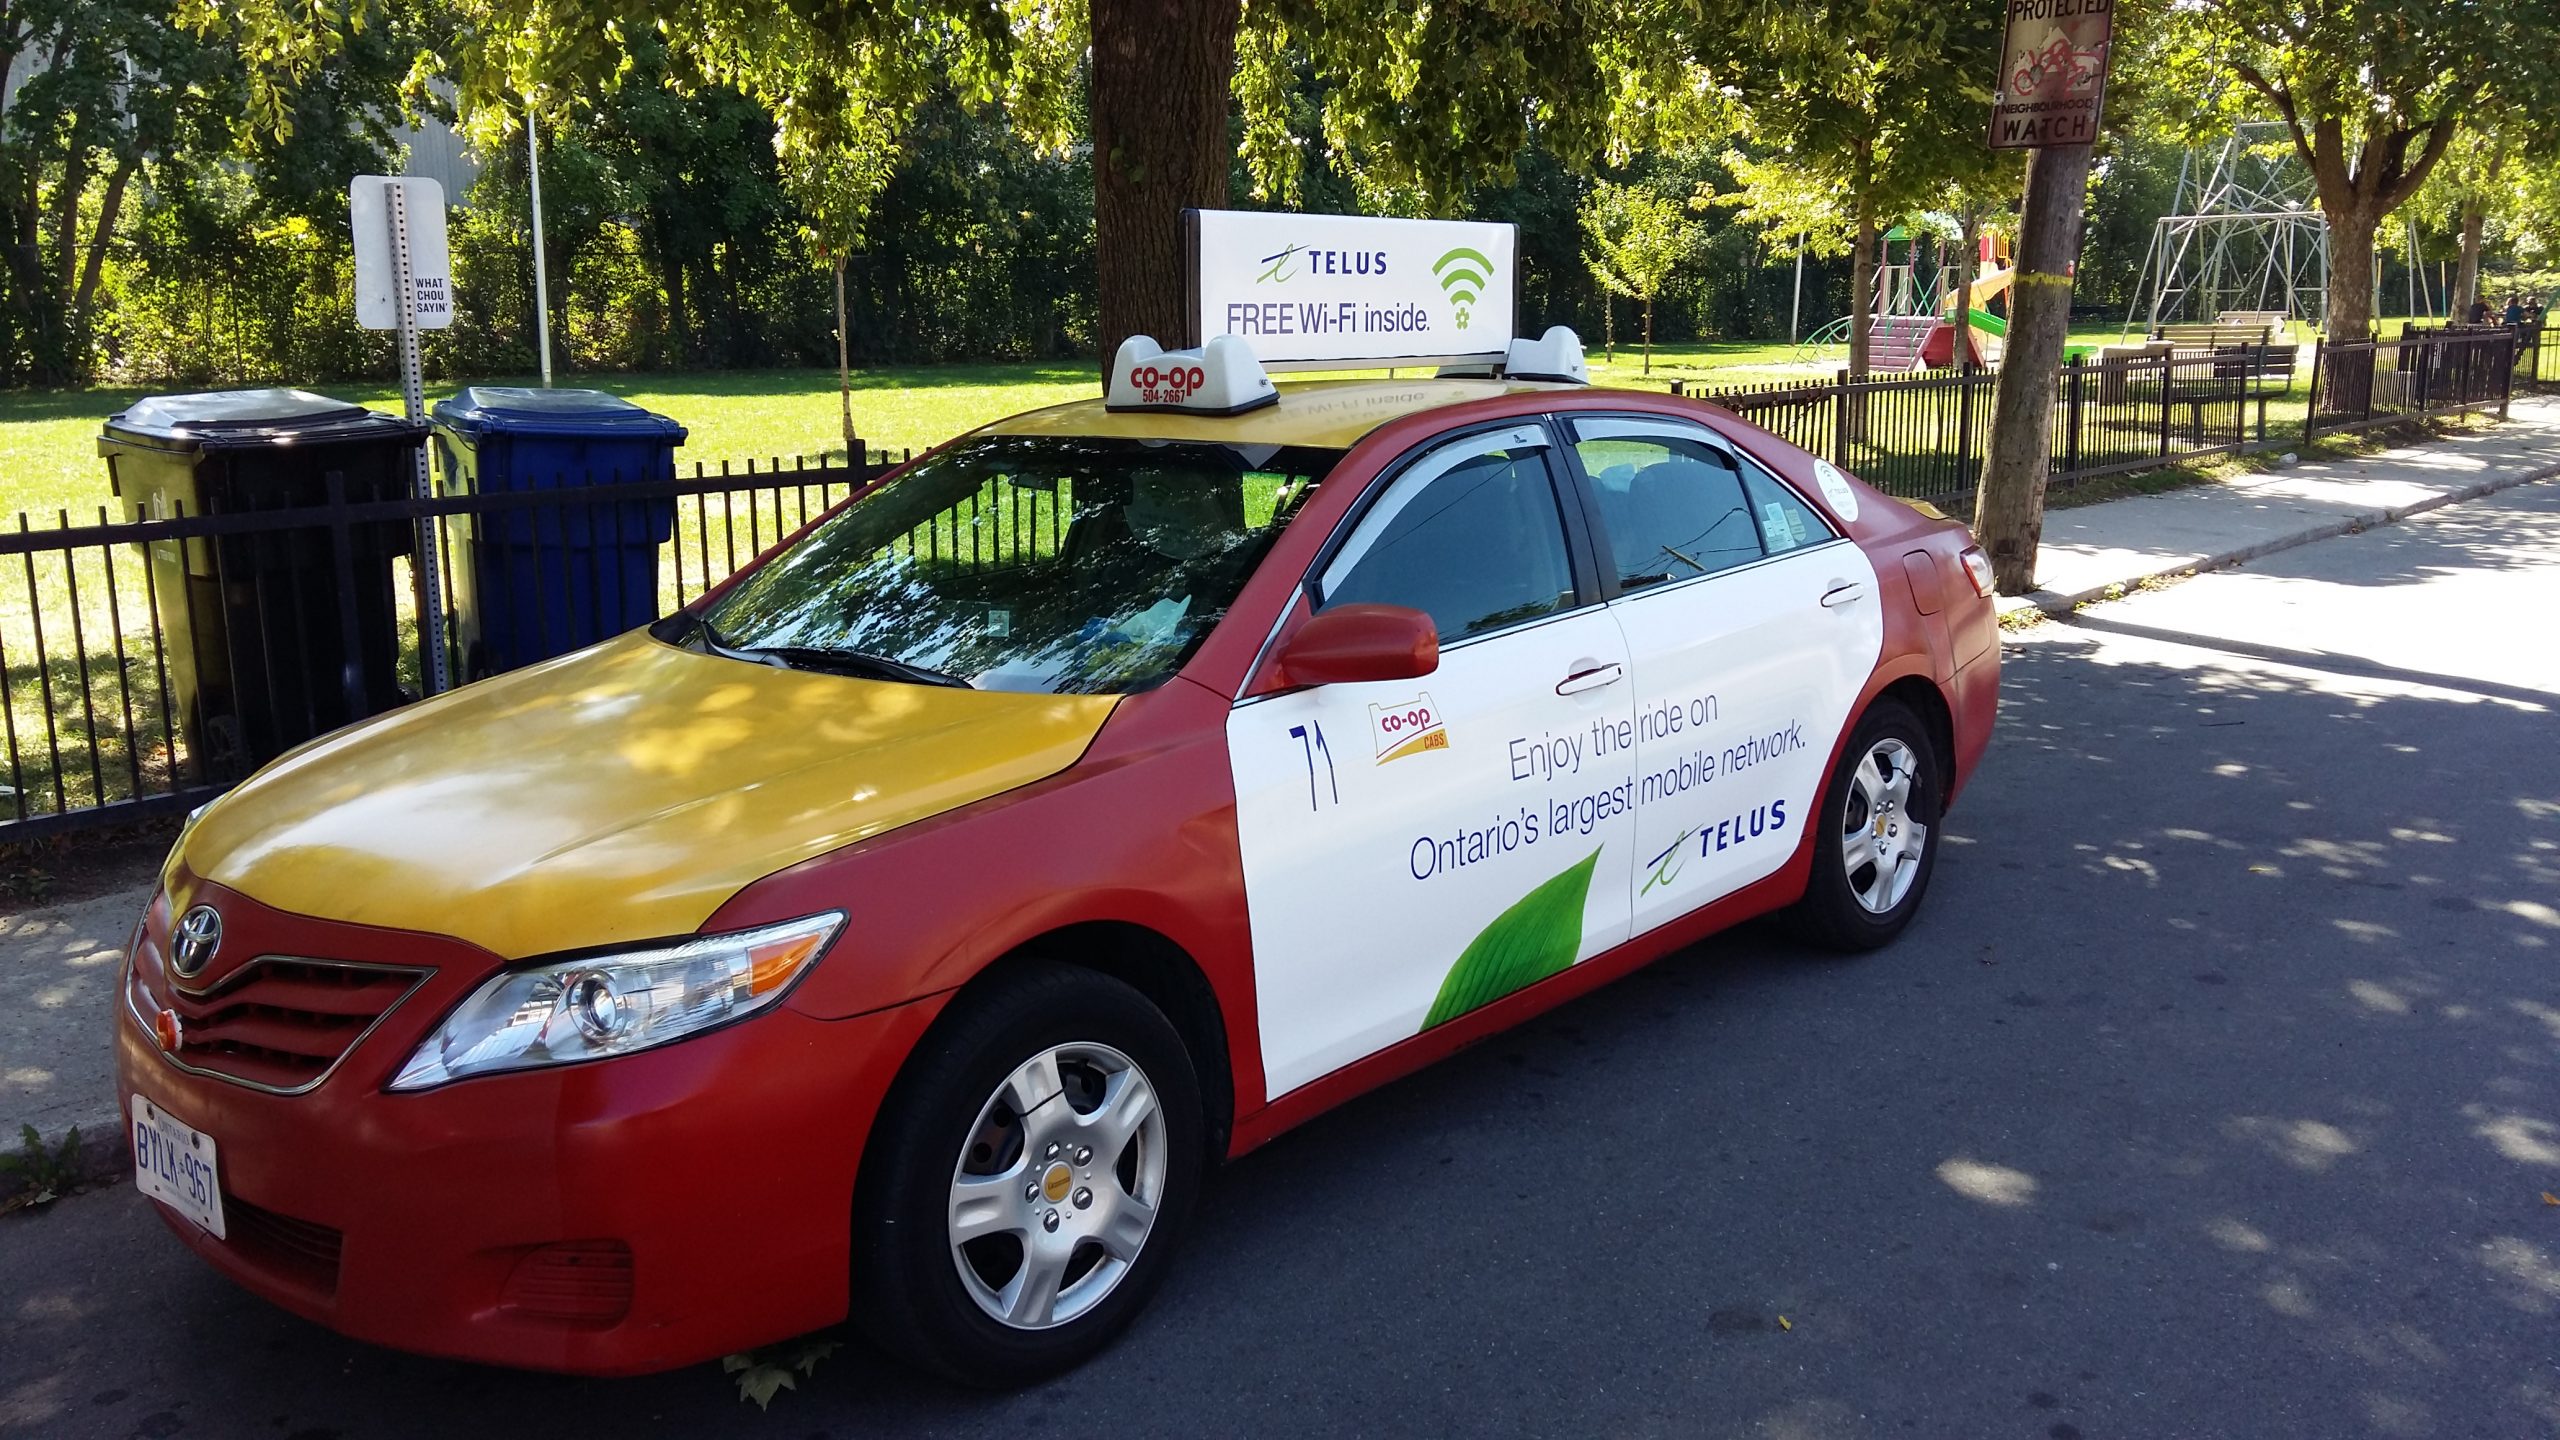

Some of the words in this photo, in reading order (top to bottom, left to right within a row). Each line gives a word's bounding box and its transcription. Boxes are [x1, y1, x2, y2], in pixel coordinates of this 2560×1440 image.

[2012, 0, 2109, 22] PROTECTED
[2000, 99, 2095, 114] NEIGHBOURHOOD
[2003, 115, 2087, 141] WATCH
[1308, 250, 1387, 275] TELUS
[415, 278, 443, 288] WHAT
[416, 302, 448, 313] SAYIN'
[417, 290, 444, 301] CHOU
[1227, 303, 1294, 335] FREE
[1298, 302, 1357, 334] Wi-Fi
[1365, 302, 1430, 333] inside.
[1130, 366, 1205, 397] co-op
[1143, 389, 1185, 403] 504-2667
[1381, 708, 1431, 732] co-op
[1423, 732, 1445, 749] CABS
[1509, 731, 1583, 781] Enjoy
[1591, 716, 1632, 756] the
[1639, 698, 1683, 743] ride
[1690, 694, 1718, 726] on
[1410, 807, 1539, 880] Ontario's
[1549, 775, 1634, 837] largest
[1641, 750, 1715, 805] mobile
[1721, 718, 1806, 776] network.
[1700, 799, 1786, 858] TELUS
